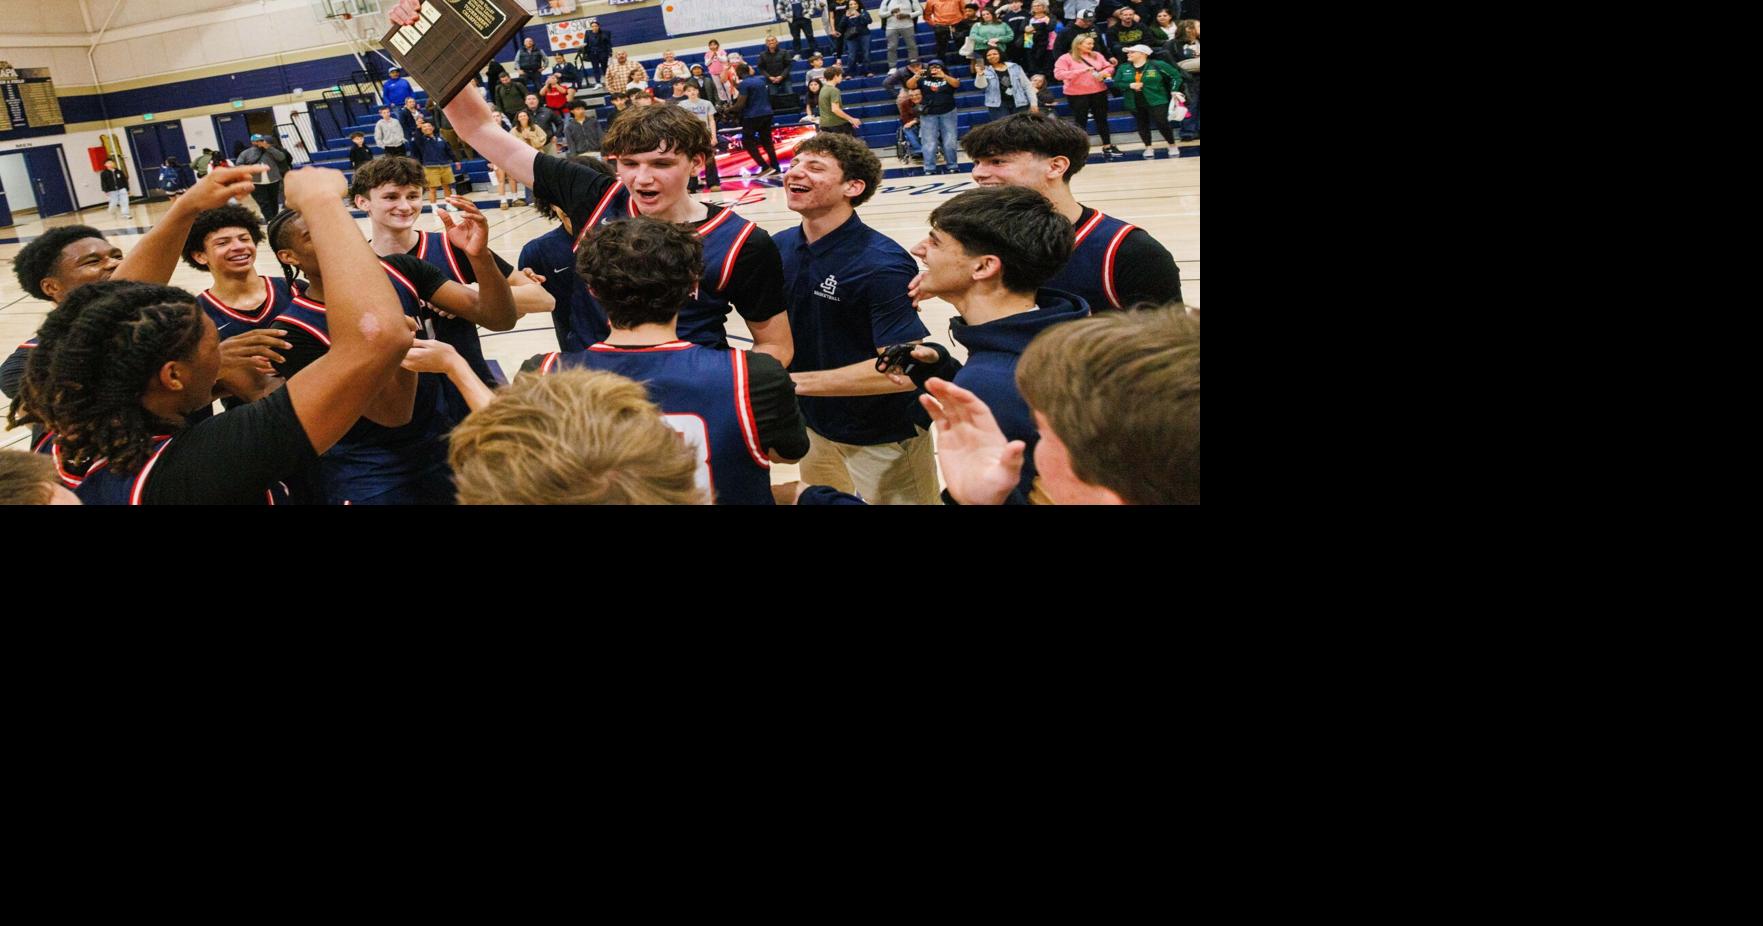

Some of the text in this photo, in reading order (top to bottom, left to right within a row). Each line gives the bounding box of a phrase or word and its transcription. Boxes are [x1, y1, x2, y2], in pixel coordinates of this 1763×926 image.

[462, 9, 484, 31] CHAMPIONS
[463, 3, 489, 28] TOURNAMENT
[814, 290, 840, 302] BASKETBALL
